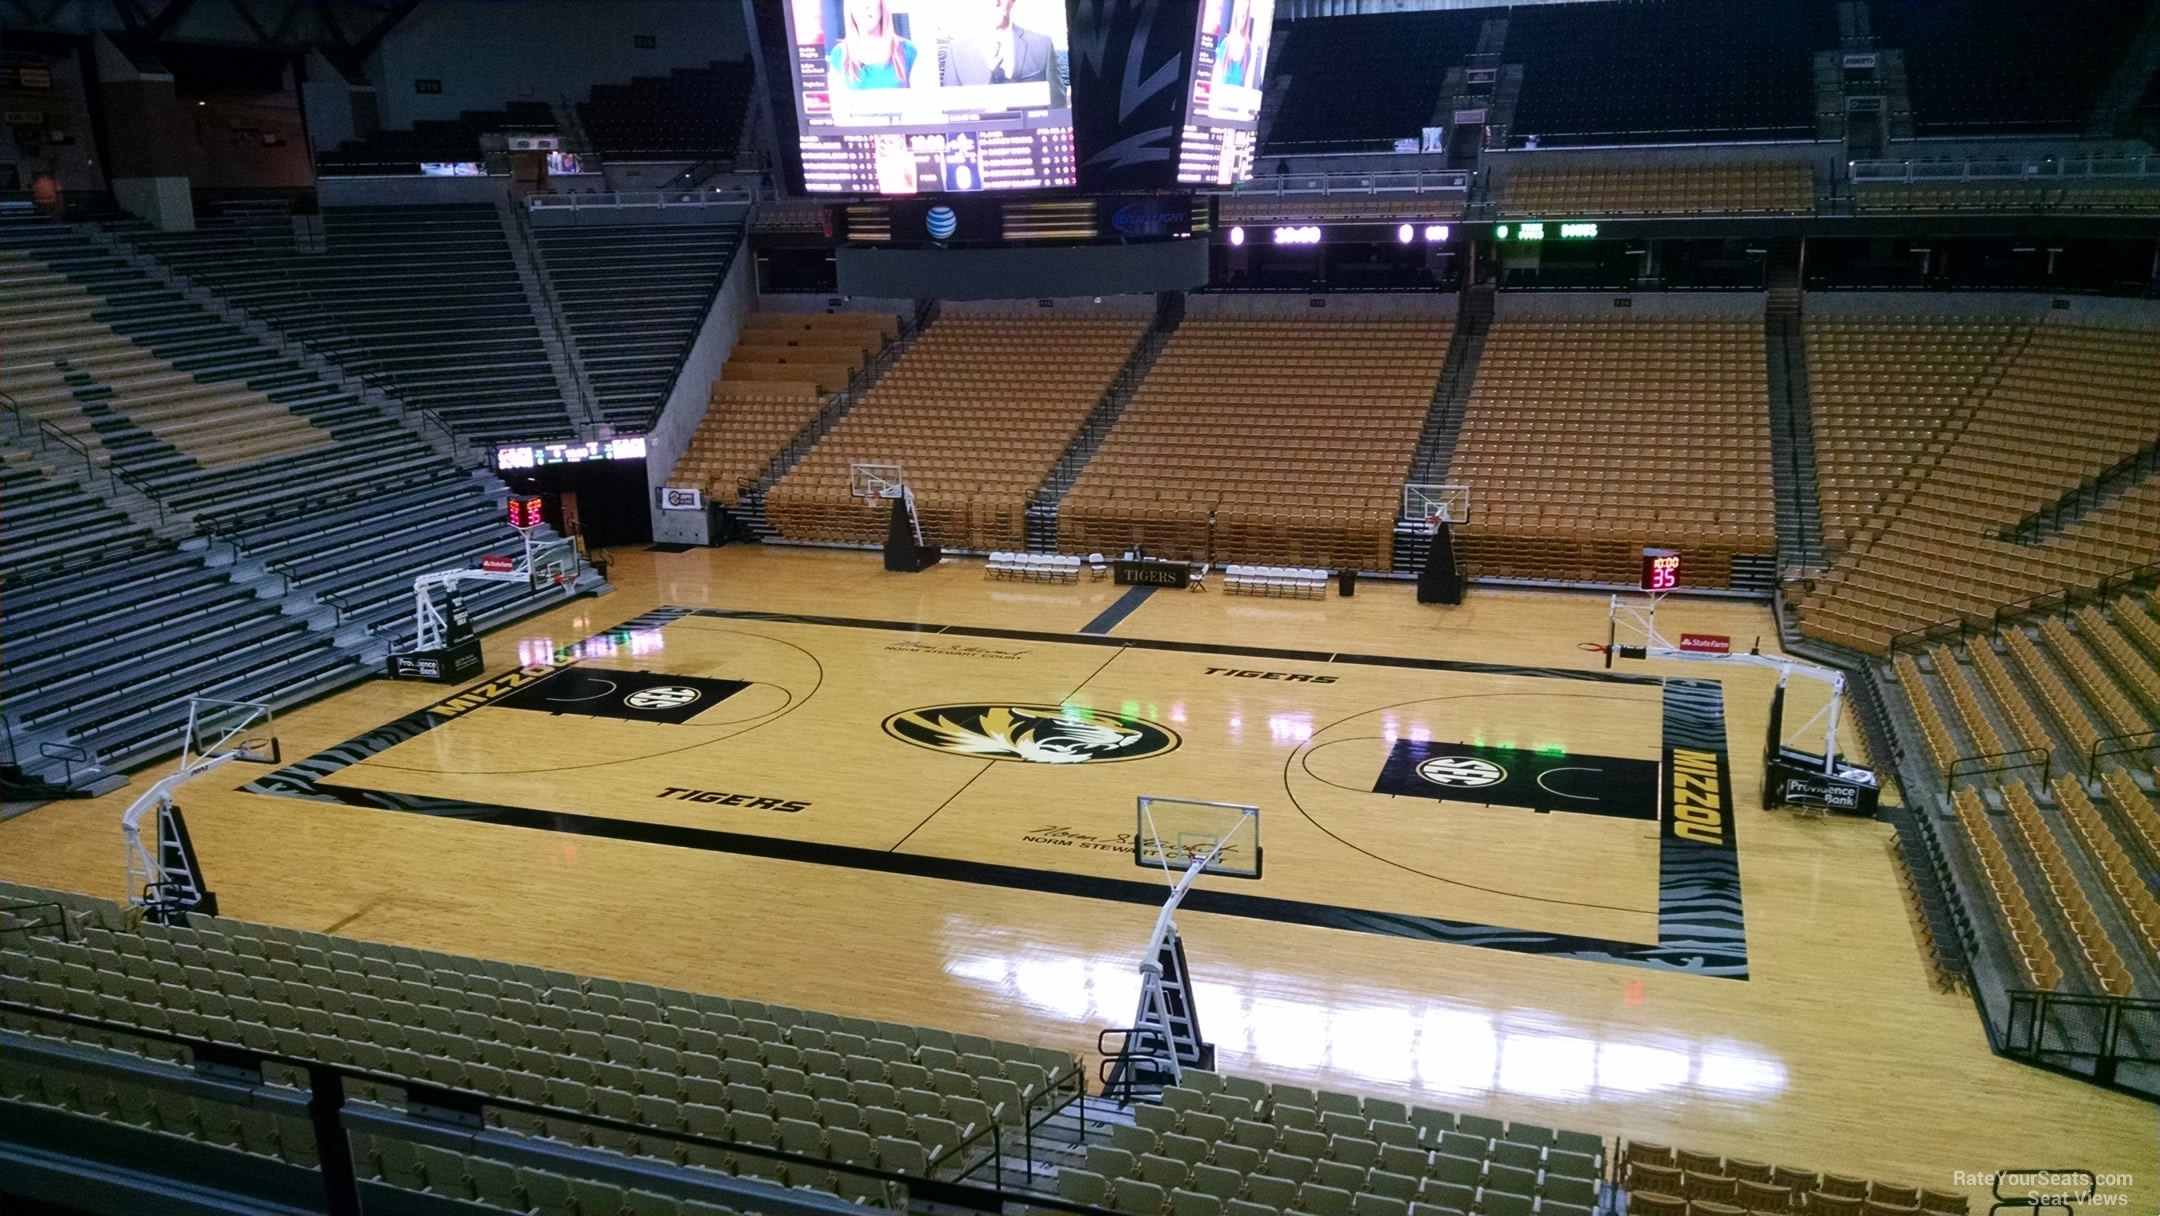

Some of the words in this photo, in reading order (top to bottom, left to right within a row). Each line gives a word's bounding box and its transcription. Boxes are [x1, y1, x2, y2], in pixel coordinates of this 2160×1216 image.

[1124, 569, 1177, 583] TIGERS
[1653, 568, 1676, 588] 35
[399, 659, 436, 669] Provence
[1204, 667, 1339, 684] TIGERS
[656, 787, 814, 813] TIGERS
[1673, 748, 1723, 845] MIZZOU
[1824, 793, 1856, 806] Bank
[1022, 835, 1073, 847] NORM
